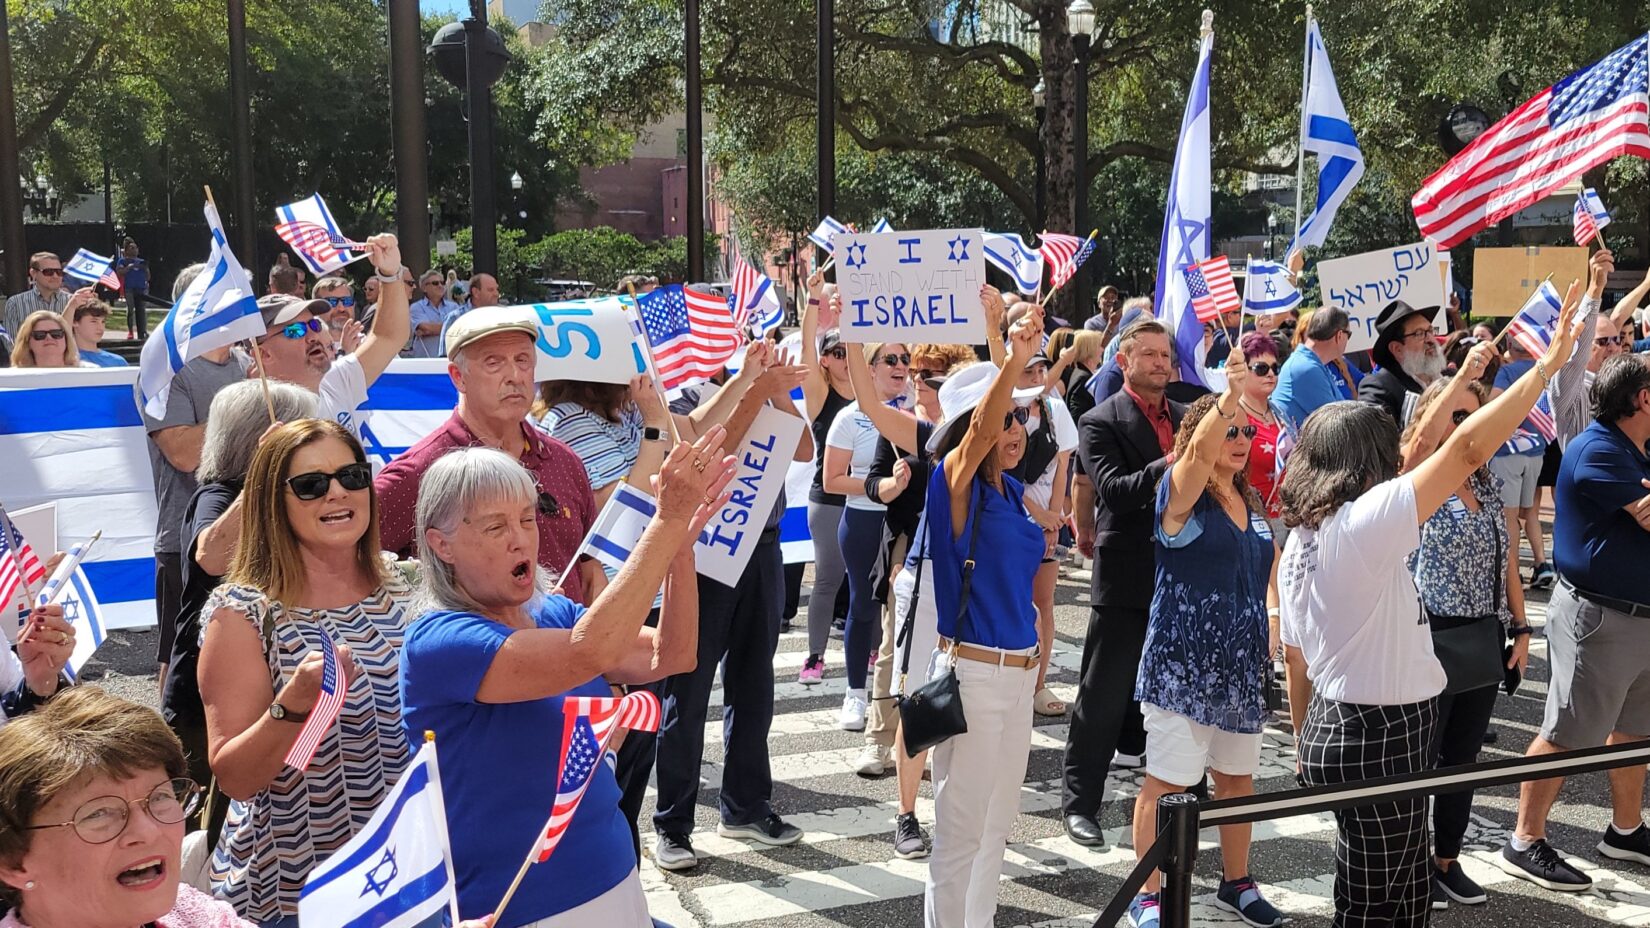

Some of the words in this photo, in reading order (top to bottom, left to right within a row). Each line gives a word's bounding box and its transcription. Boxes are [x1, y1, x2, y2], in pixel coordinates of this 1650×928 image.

[898, 238, 921, 263] I
[1393, 246, 1430, 272] עם
[850, 271, 903, 296] STAND
[916, 269, 979, 292] WITH
[1330, 274, 1409, 308] ישראל
[851, 294, 968, 328] ISRAEL
[709, 434, 776, 557] ISRAEL
